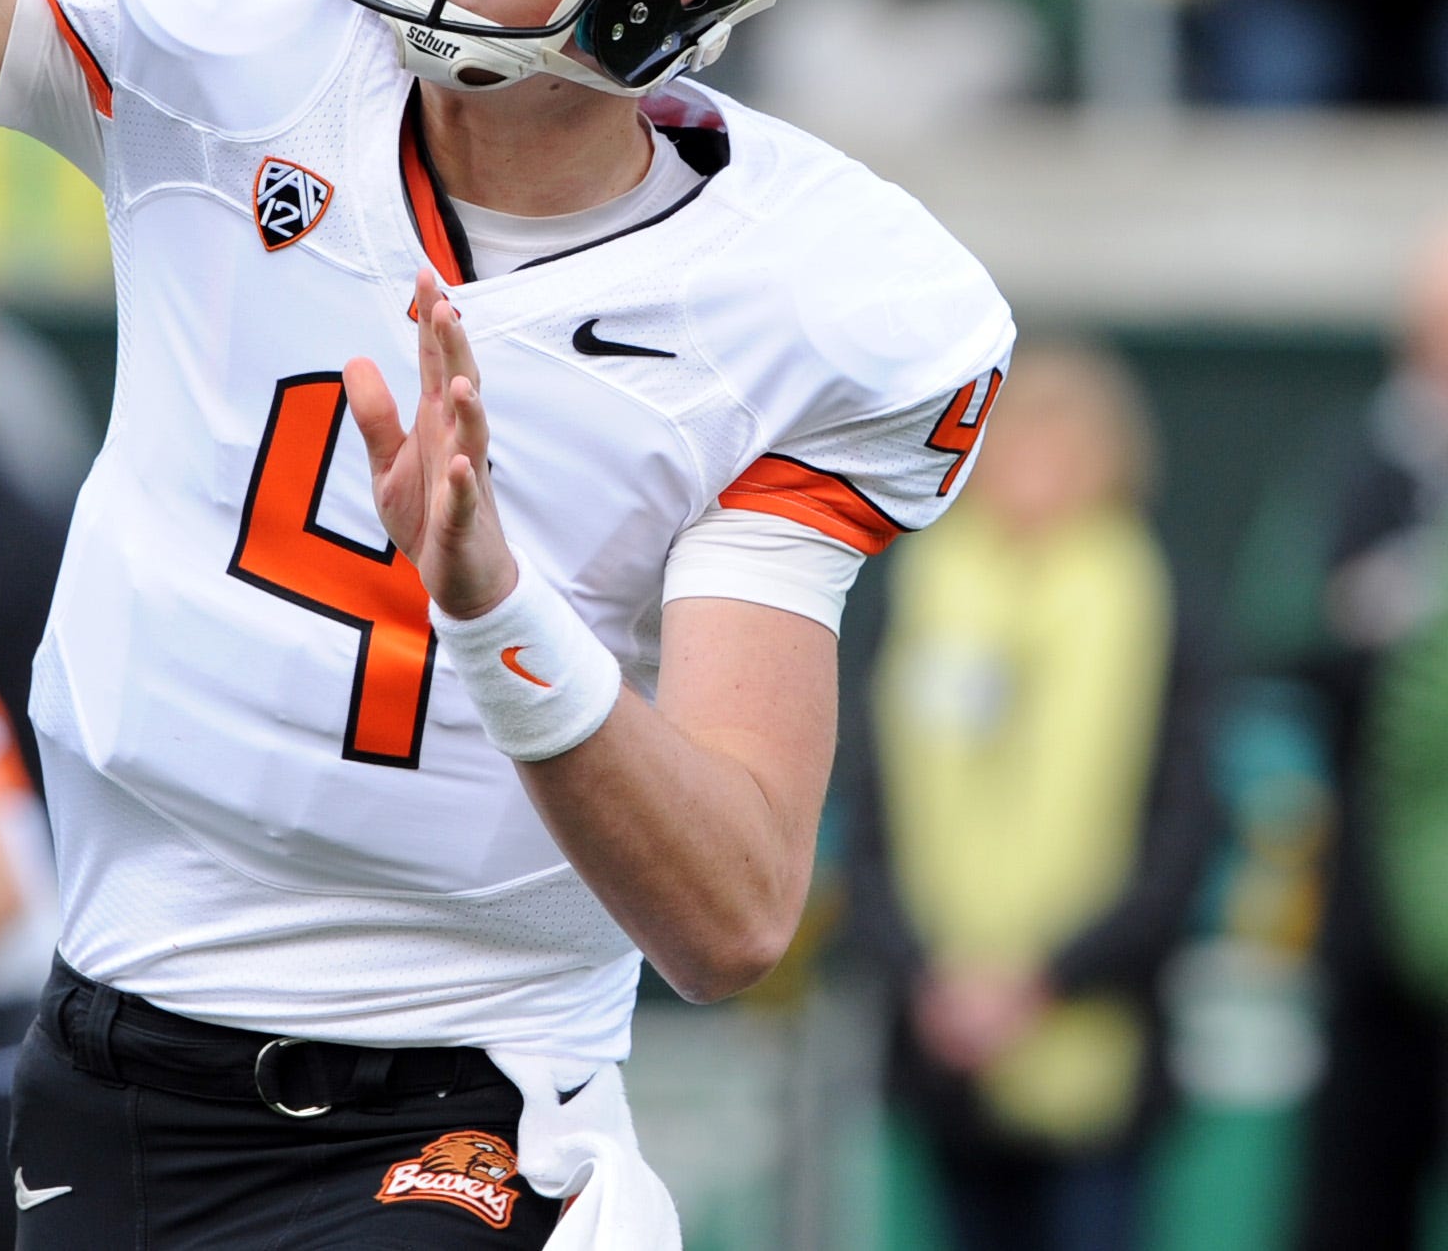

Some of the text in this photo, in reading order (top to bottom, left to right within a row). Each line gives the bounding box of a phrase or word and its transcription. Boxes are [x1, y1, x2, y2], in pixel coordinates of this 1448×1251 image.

[406, 25, 461, 60] schutt
[257, 160, 329, 229] PAC
[260, 197, 301, 238] 12
[924, 366, 1003, 497] 4
[226, 371, 440, 769] 4
[385, 1163, 511, 1219] Beavers
